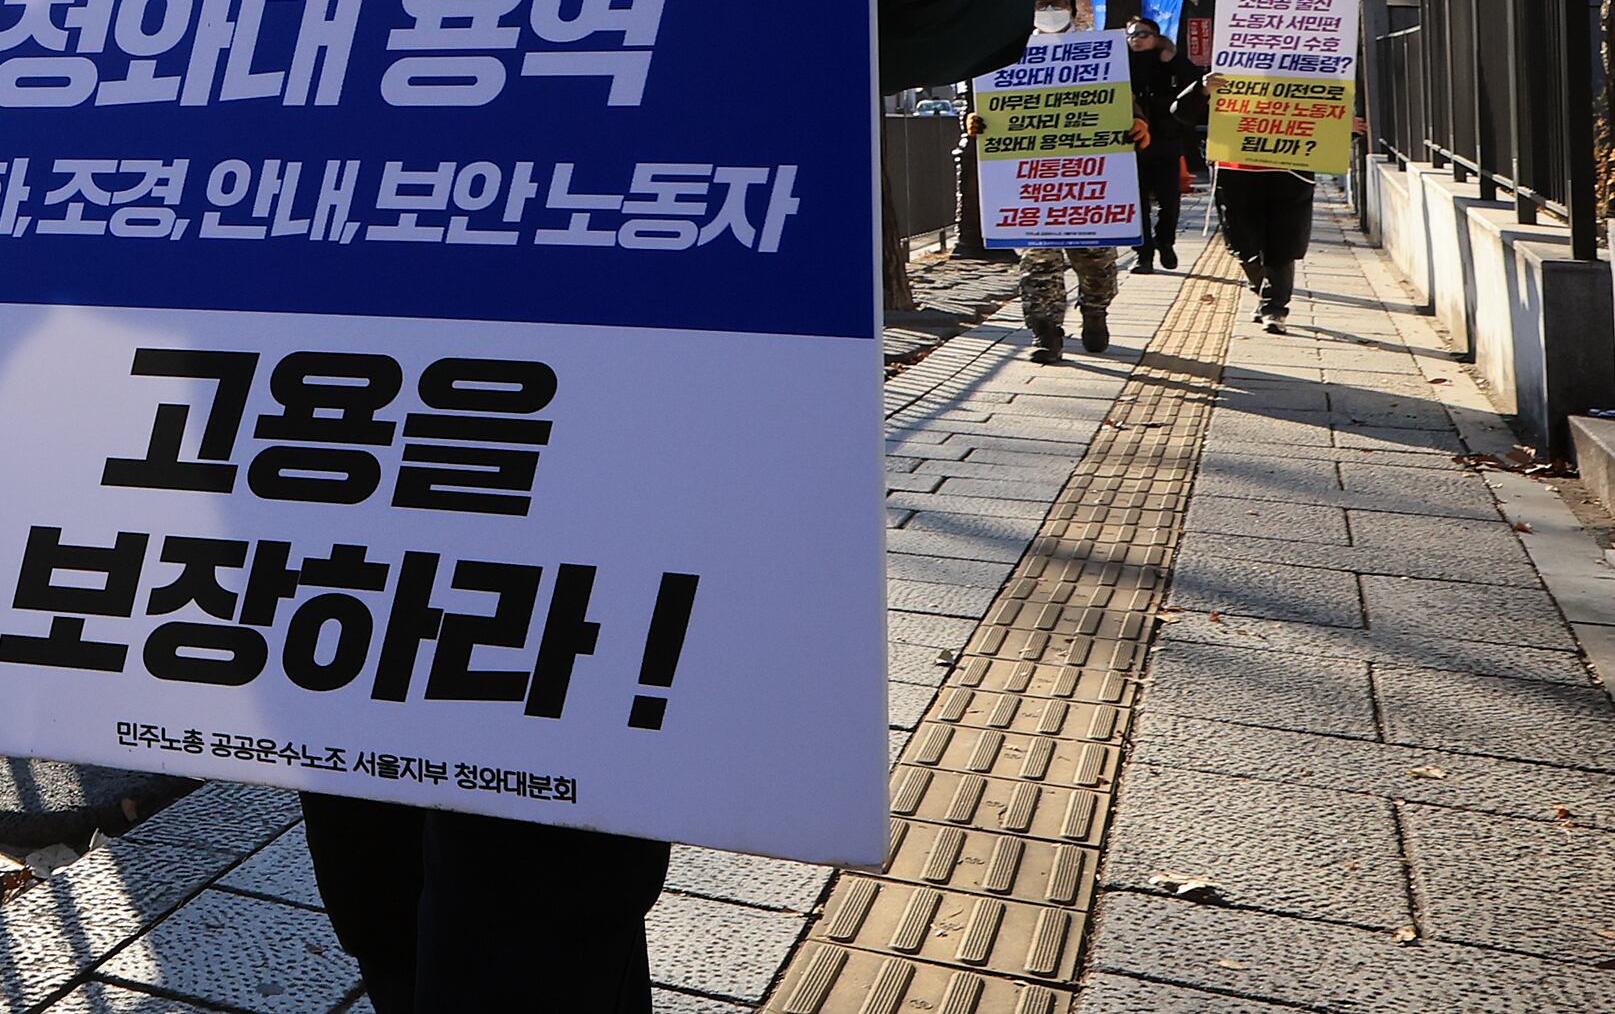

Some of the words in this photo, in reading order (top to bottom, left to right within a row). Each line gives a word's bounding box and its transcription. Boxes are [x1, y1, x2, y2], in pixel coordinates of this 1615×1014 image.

[1228, 13, 1283, 30] 노동자
[1286, 15, 1341, 32] 서민편
[1051, 40, 1113, 62] 대통령
[1228, 33, 1300, 50] 민주주의
[1303, 36, 1341, 52] 수호
[1215, 51, 1276, 69] 이재명
[1278, 53, 1353, 73] 대통령?
[994, 66, 1055, 88] 청와대
[989, 94, 1041, 111] 아무런
[1044, 88, 1115, 108] 대책없이
[1273, 83, 1345, 101] 이전으로
[1253, 100, 1290, 116] 보안
[1291, 102, 1346, 120] 노동자
[1008, 113, 1059, 131] 일자리
[1237, 117, 1316, 136] 쫓아내도
[984, 135, 1036, 153] 청와대
[1016, 156, 1105, 179] 대통령이
[1019, 180, 1108, 202] 책임지고
[534, 163, 801, 253] 노동자
[996, 207, 1041, 227] 고용
[1044, 203, 1136, 226] 보장하라
[101, 346, 558, 517] 고용을
[116, 721, 205, 755] 민주노총
[210, 731, 348, 773] 공공운수노조
[353, 752, 448, 785] 서울지부
[453, 762, 578, 804] 청와대분회
